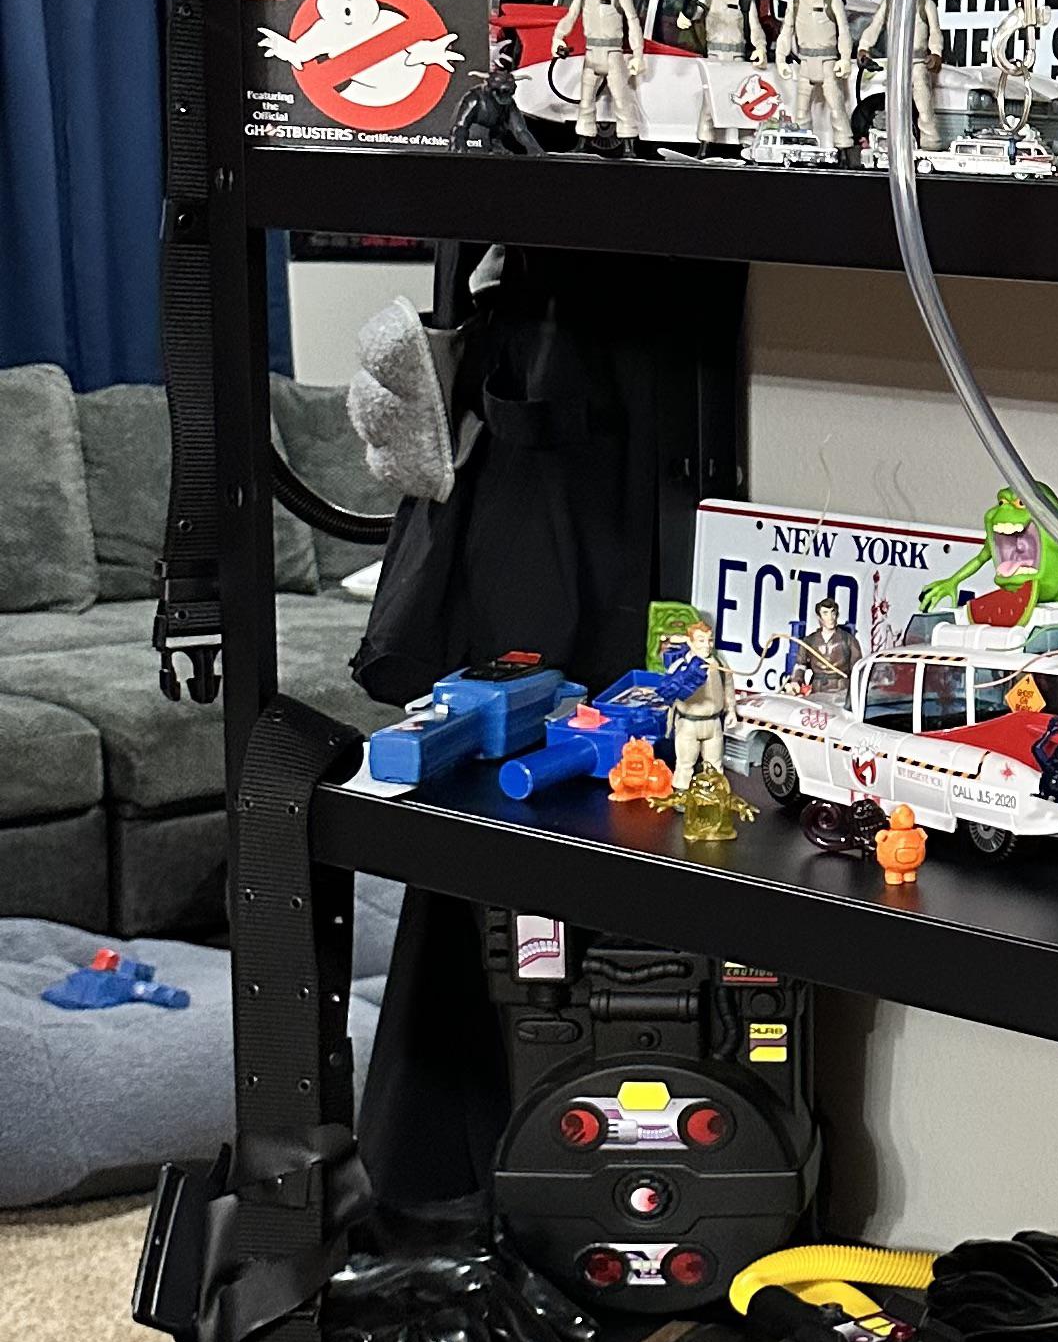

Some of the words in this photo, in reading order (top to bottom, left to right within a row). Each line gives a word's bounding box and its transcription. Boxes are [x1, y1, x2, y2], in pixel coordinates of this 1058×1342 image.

[247, 90, 294, 105] Featuring
[262, 101, 279, 111] the
[252, 110, 289, 122] Official
[244, 122, 353, 142] GHOSTBUSTERS
[357, 131, 408, 145] Certificate
[409, 134, 420, 145] of
[420, 135, 483, 148] Achieent
[771, 525, 838, 559] NEW
[851, 534, 929, 570] YORK
[952, 784, 974, 801] CALL
[977, 790, 1017, 810] JL5-2020
